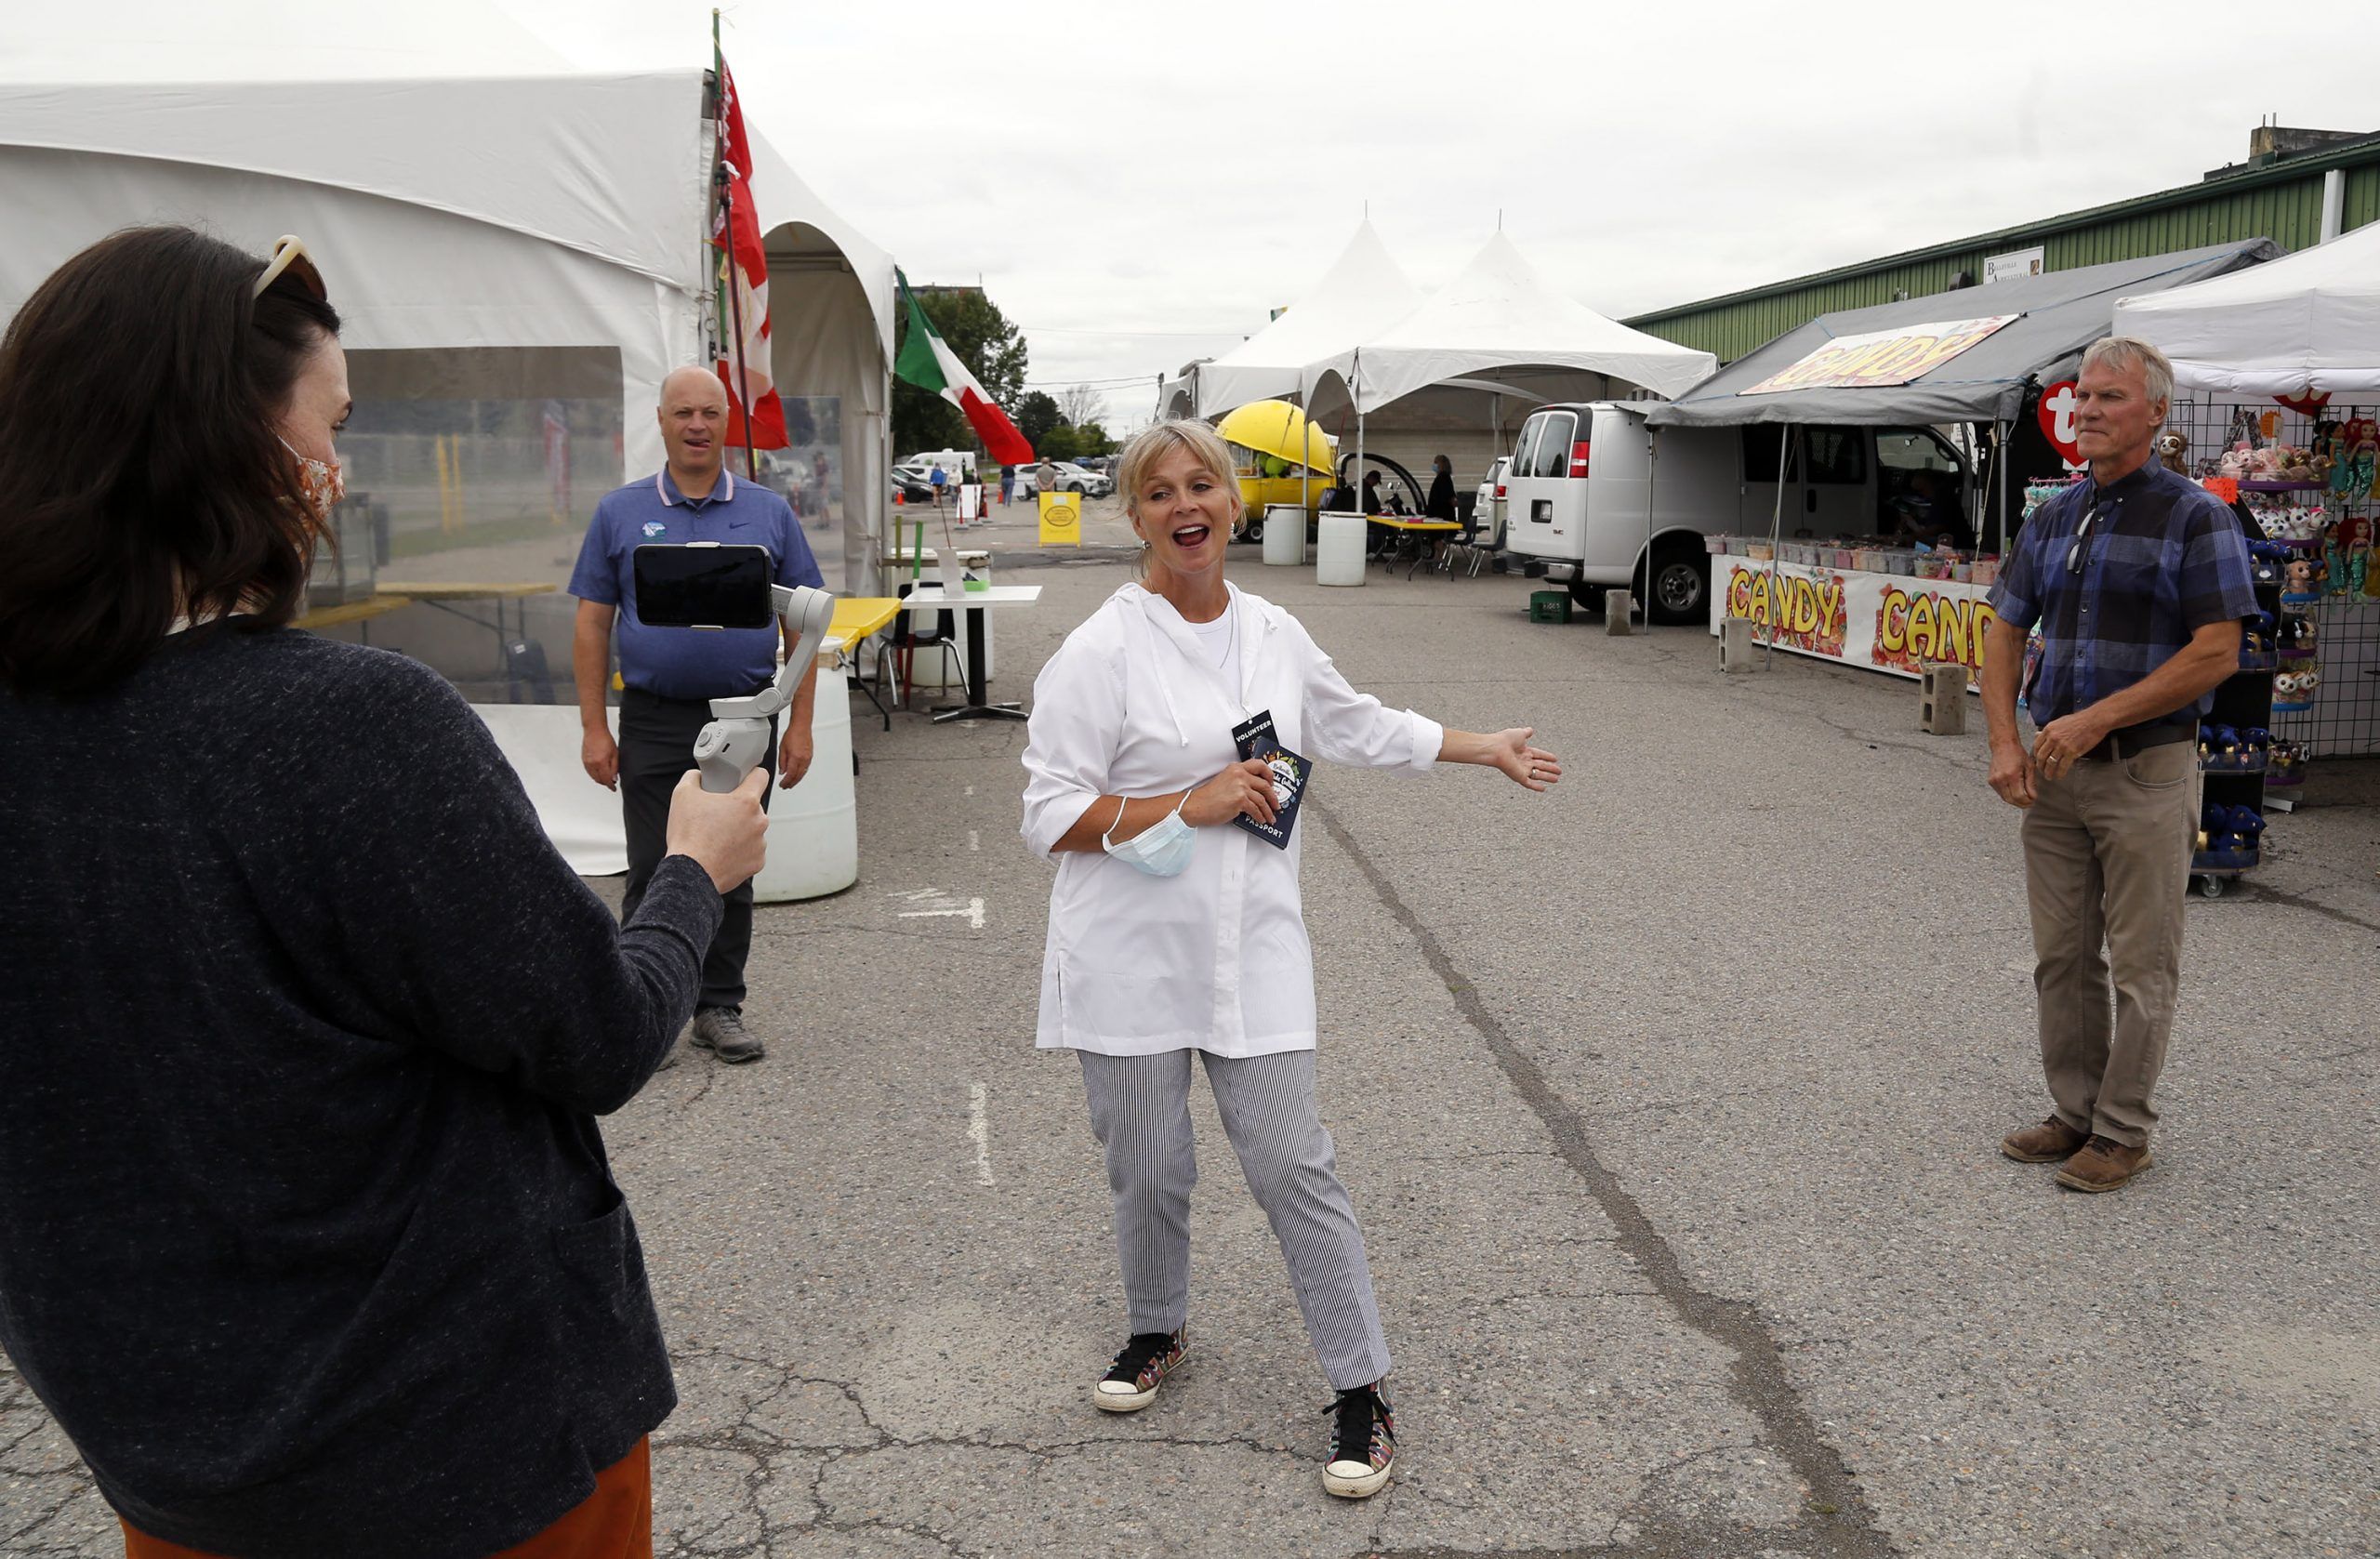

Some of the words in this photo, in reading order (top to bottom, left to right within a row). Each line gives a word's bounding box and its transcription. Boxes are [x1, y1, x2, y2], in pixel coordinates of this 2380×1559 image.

[2045, 387, 2077, 443] t
[1730, 568, 1841, 639] CANDY
[1236, 720, 1272, 743] VOLUNTEER
[1245, 816, 1283, 839] PASSPORT
